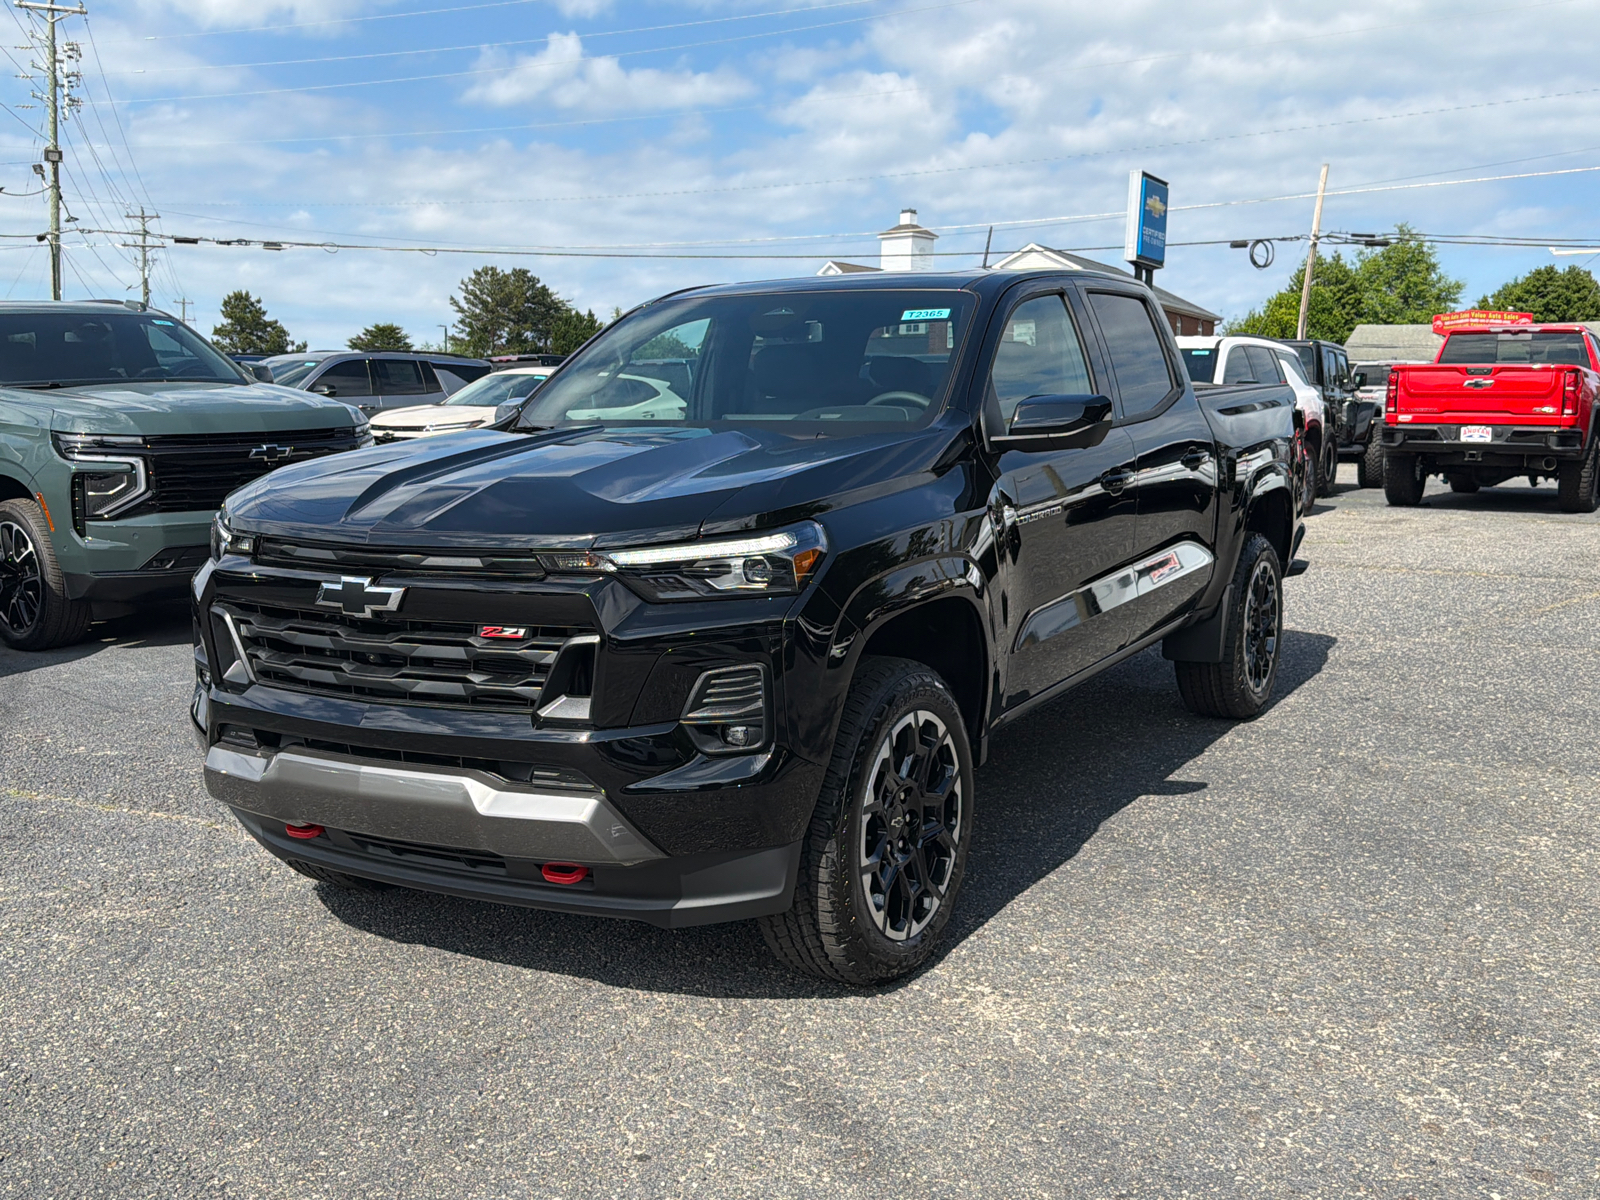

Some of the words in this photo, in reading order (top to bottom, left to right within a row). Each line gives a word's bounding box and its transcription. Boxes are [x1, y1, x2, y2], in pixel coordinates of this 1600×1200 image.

[908, 310, 944, 318] T2365
[1471, 311, 1486, 319] Value
[1015, 506, 1062, 526] COLORADO
[480, 626, 527, 639] Z71
